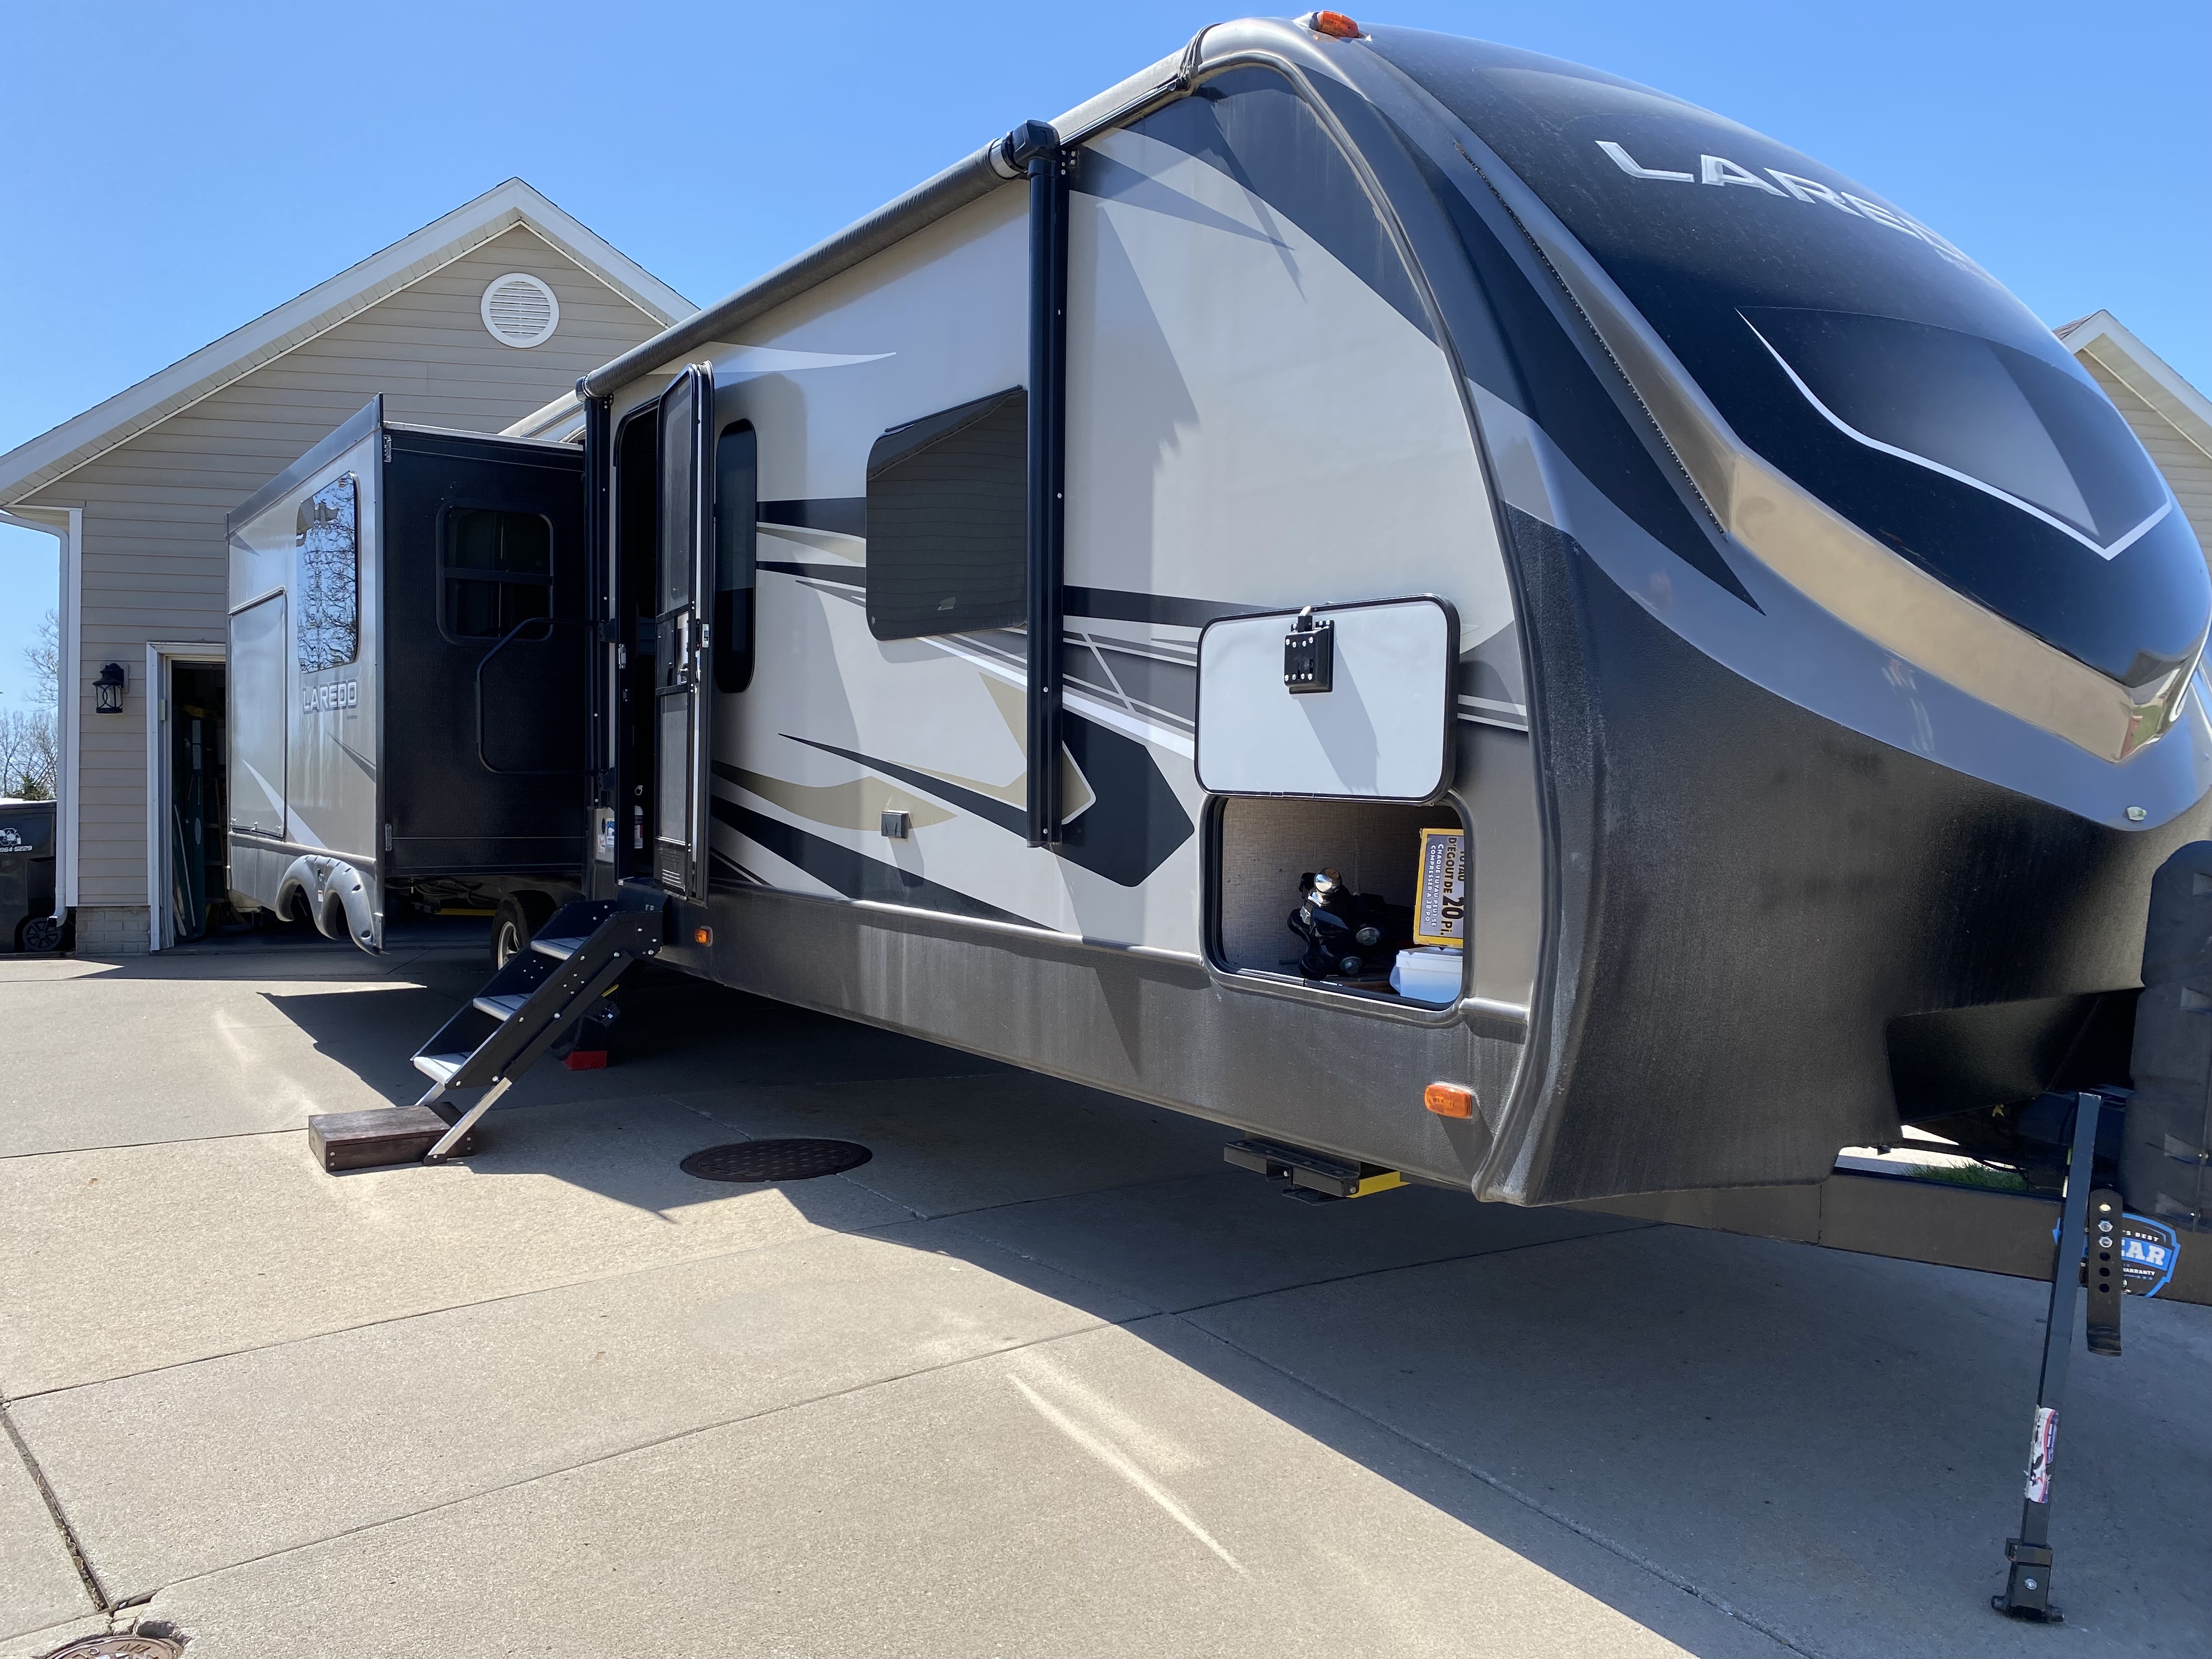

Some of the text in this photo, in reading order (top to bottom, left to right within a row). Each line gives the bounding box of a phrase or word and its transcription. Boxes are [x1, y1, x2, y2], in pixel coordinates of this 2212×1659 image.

[302, 679, 357, 714] LAREDO
[1427, 845, 1436, 891] COMPRESSER
[1435, 843, 1444, 873] CHAQUE
[1444, 837, 1459, 879] D'ÉGOUT
[1443, 881, 1453, 894] DE
[1426, 900, 1432, 910] 38
[1441, 895, 1464, 919] 20
[1431, 918, 1437, 927] SE
[2121, 1239, 2166, 1266] AR
